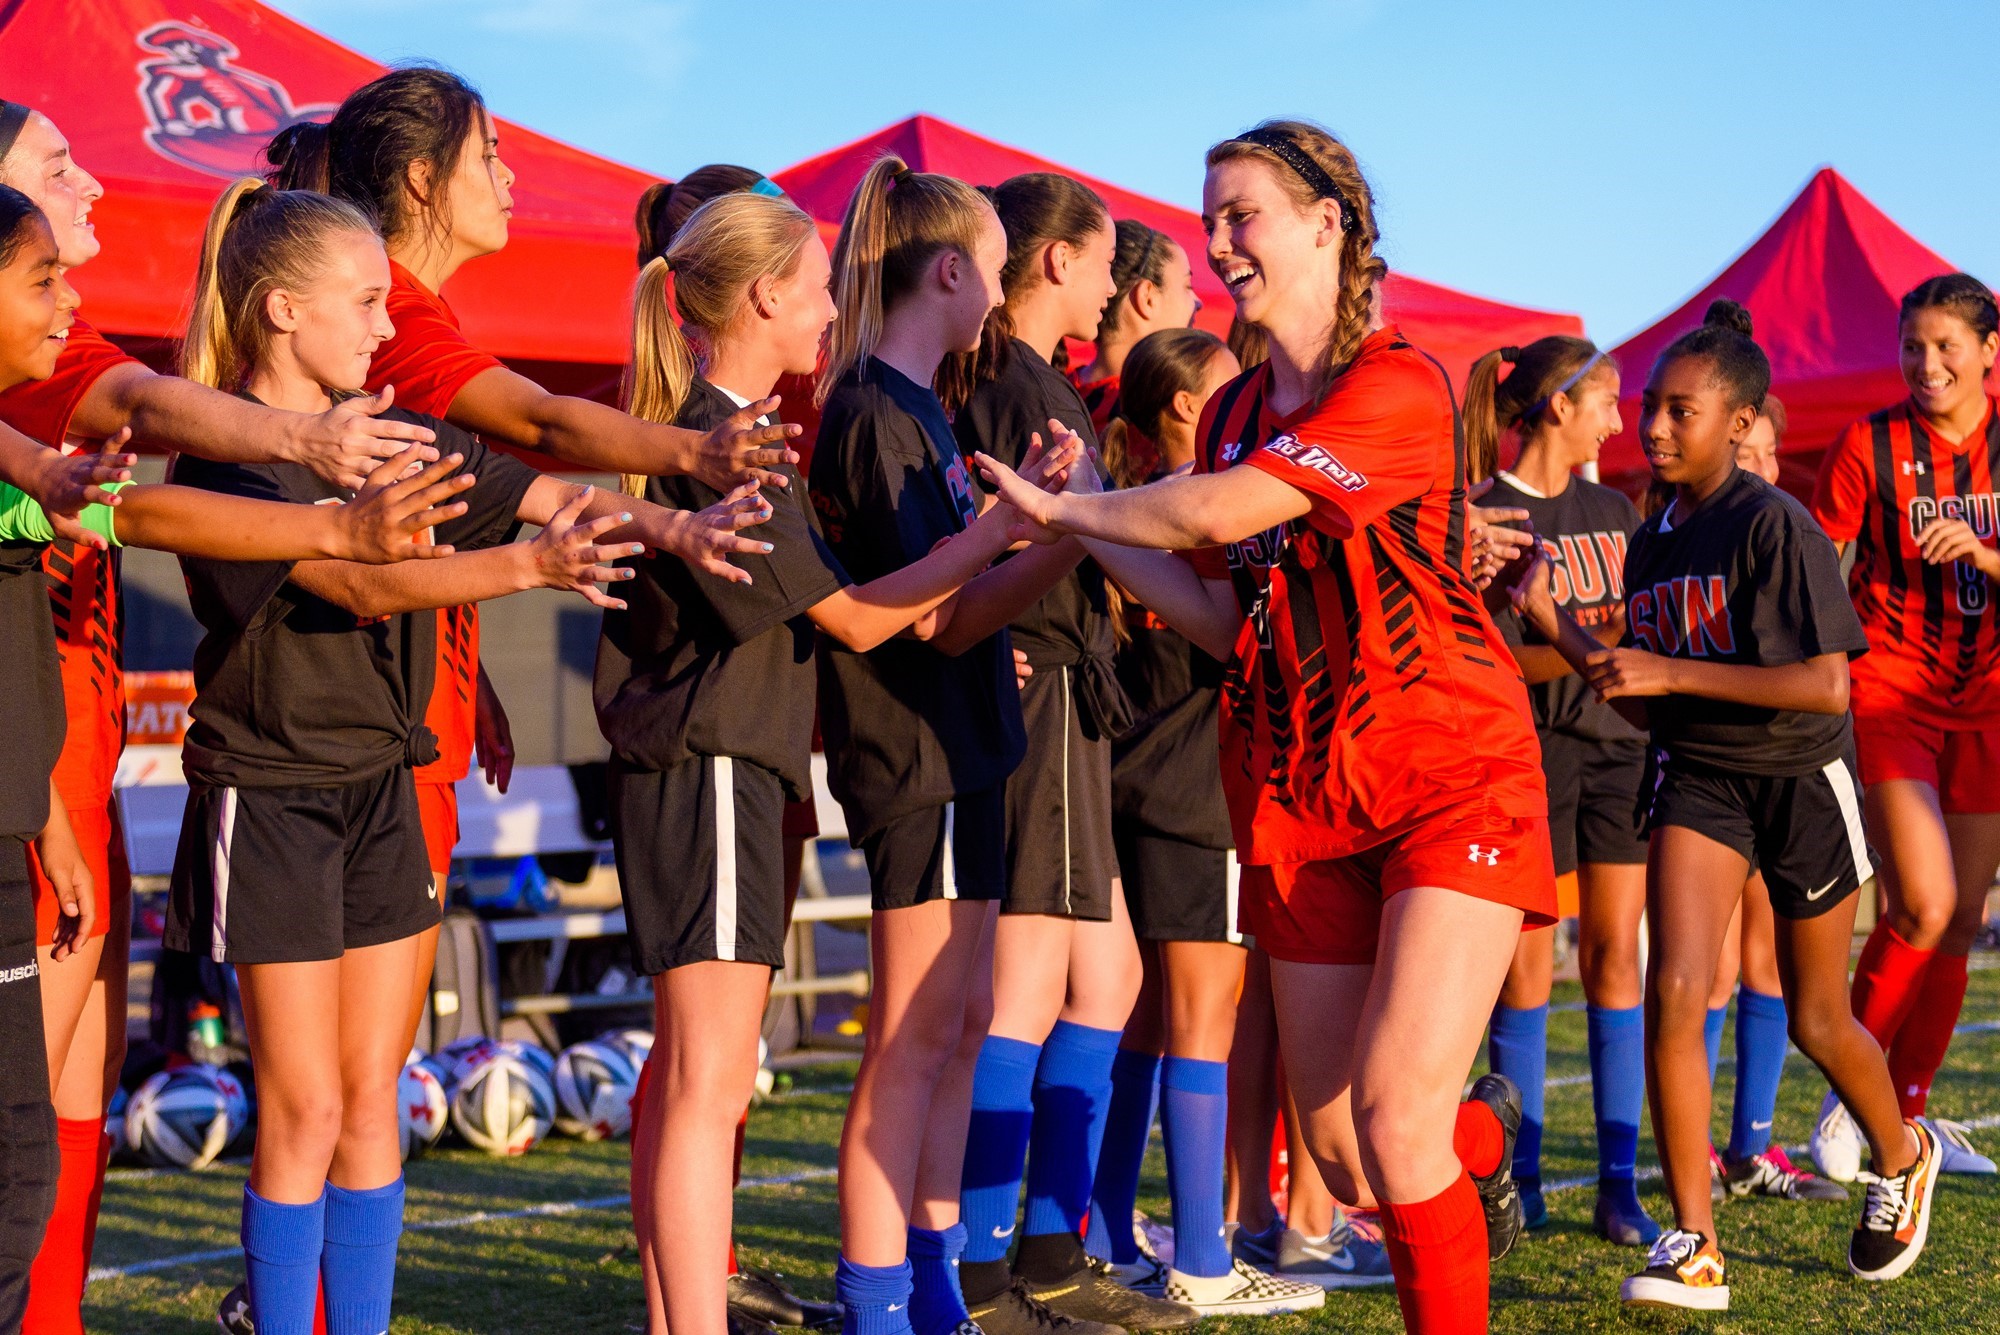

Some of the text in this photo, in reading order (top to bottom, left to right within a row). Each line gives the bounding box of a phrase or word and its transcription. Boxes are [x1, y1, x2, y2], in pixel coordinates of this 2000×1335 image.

[1909, 493, 2000, 546] CSU
[1542, 531, 1627, 606] SUN
[1628, 574, 1737, 657] SUN
